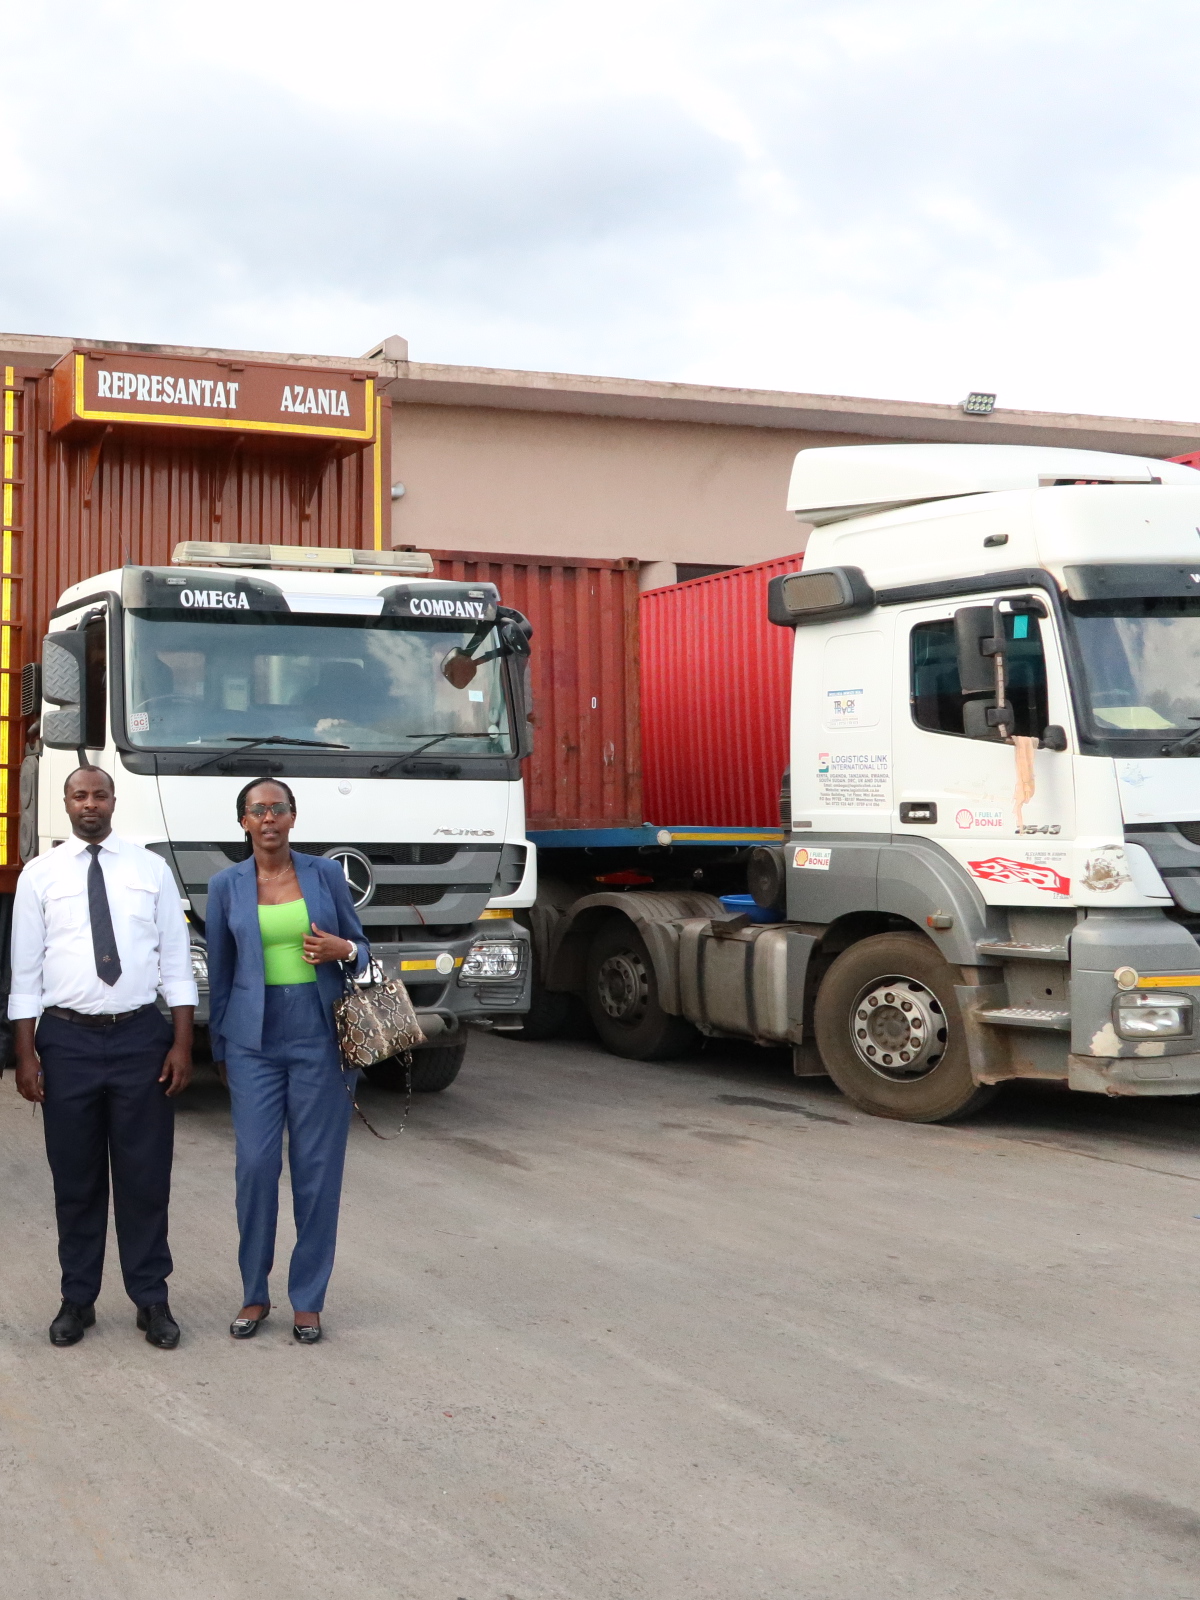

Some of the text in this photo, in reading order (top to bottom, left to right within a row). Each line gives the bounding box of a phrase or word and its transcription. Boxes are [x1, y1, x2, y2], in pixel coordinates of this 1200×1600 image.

[98, 370, 350, 417] REPRESANTAT AZANIA
[180, 589, 485, 619] OMEGA COMPANY
[831, 755, 869, 763] LOGISTICS
[808, 858, 830, 866] BONJE
